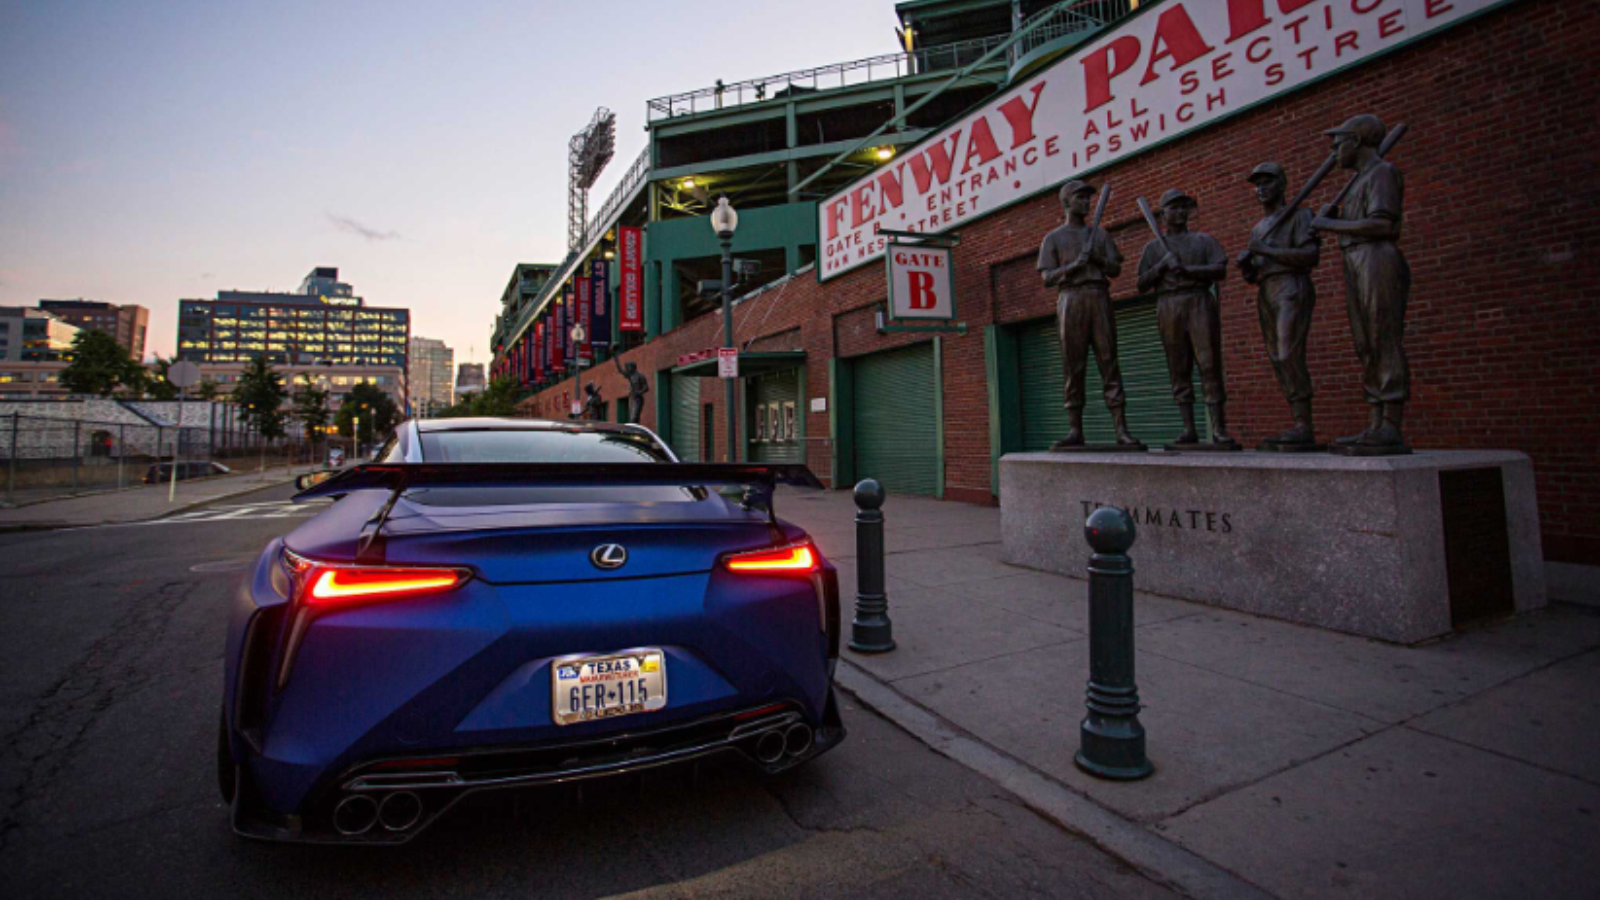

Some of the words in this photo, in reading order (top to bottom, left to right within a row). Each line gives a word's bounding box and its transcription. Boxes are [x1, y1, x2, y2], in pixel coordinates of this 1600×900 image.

[826, 80, 1046, 241] FENWAY
[826, 231, 862, 257] GATE
[927, 135, 1060, 212] ENTRANCE
[1083, 98, 1148, 140] ALL
[826, 254, 849, 271] VAN
[907, 195, 979, 233] STREET
[1072, 88, 1225, 168] IPSWICH
[895, 252, 945, 268] GATE
[907, 270, 937, 309] B
[1080, 501, 1232, 533] TMMATES
[588, 660, 631, 674] TEXAS
